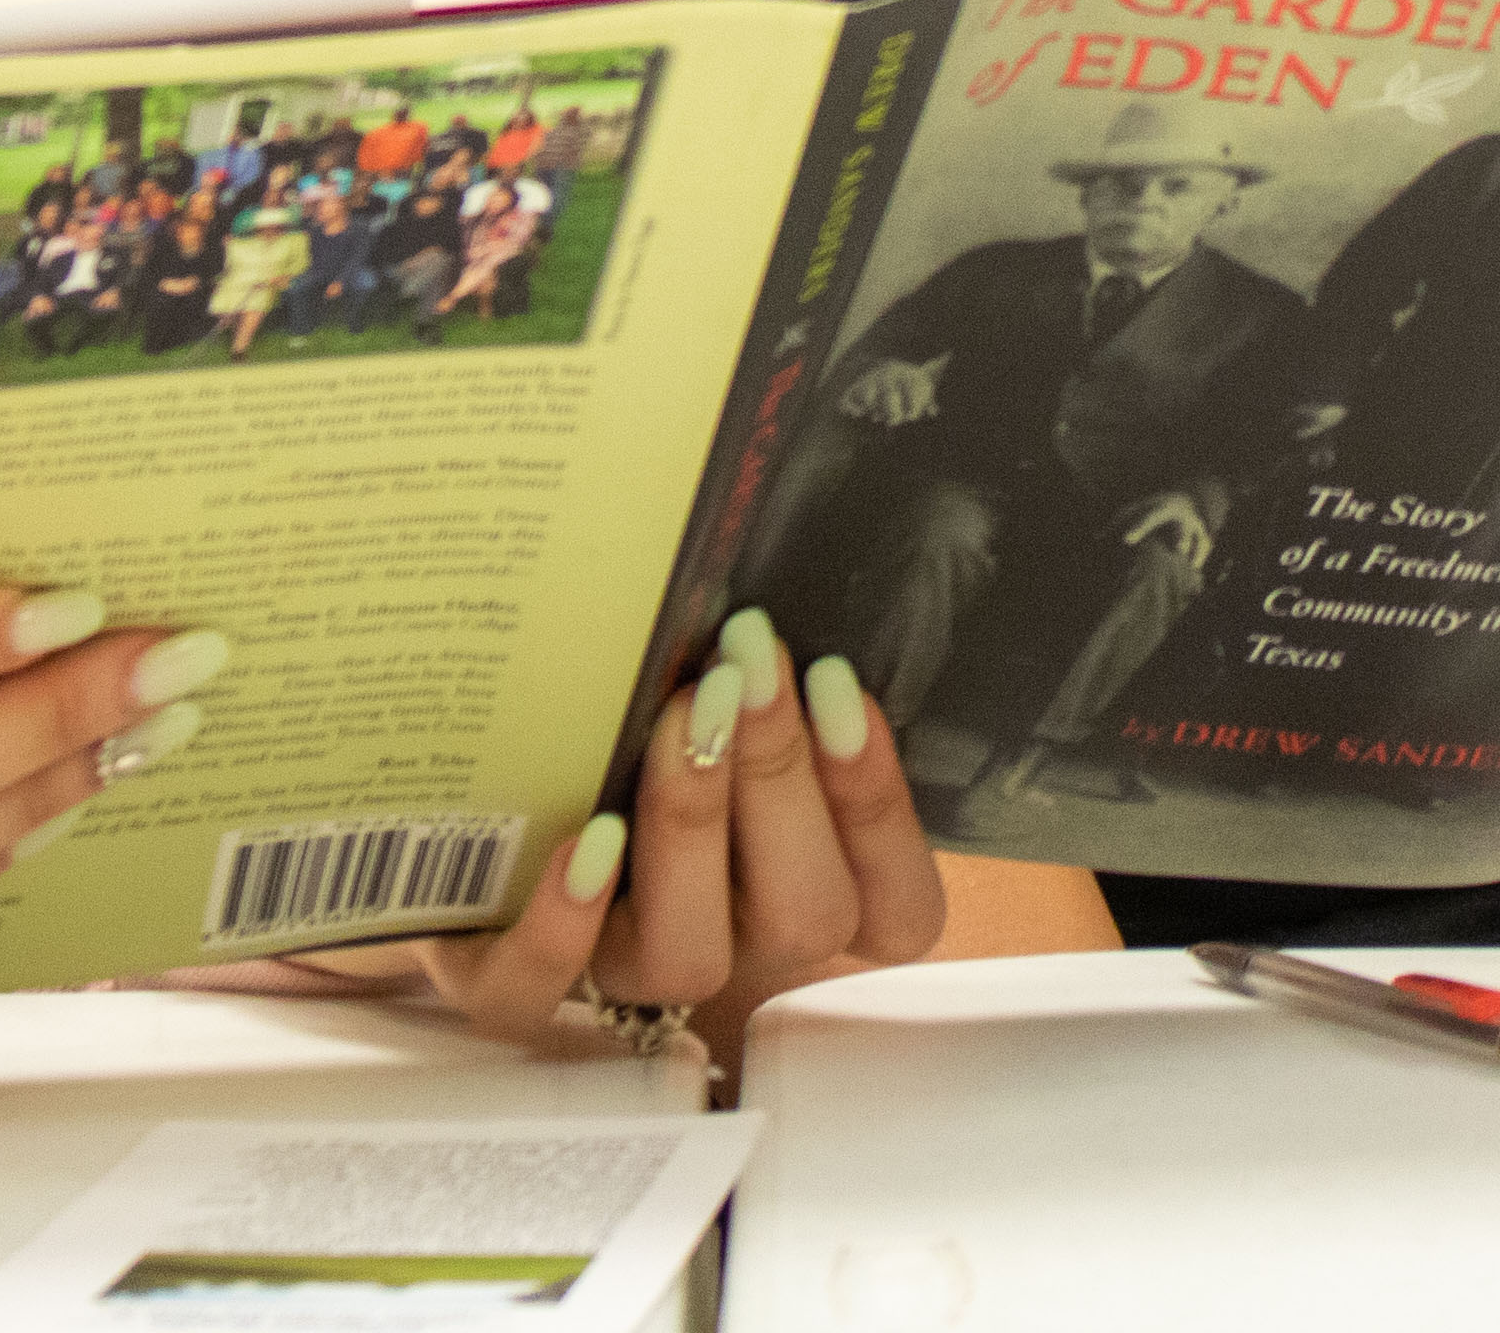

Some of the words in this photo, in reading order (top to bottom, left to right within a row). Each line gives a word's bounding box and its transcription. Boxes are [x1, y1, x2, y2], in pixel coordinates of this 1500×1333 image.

[965, 31, 1060, 107] of
[1057, 32, 1355, 112] EDEN
[1307, 485, 1377, 527] The
[1381, 489, 1488, 537] Story
[1279, 536, 1327, 578] of
[1324, 548, 1351, 573] a
[1262, 587, 1471, 635] Community
[1244, 632, 1345, 673] Texas
[1172, 717, 1319, 757] DREW
